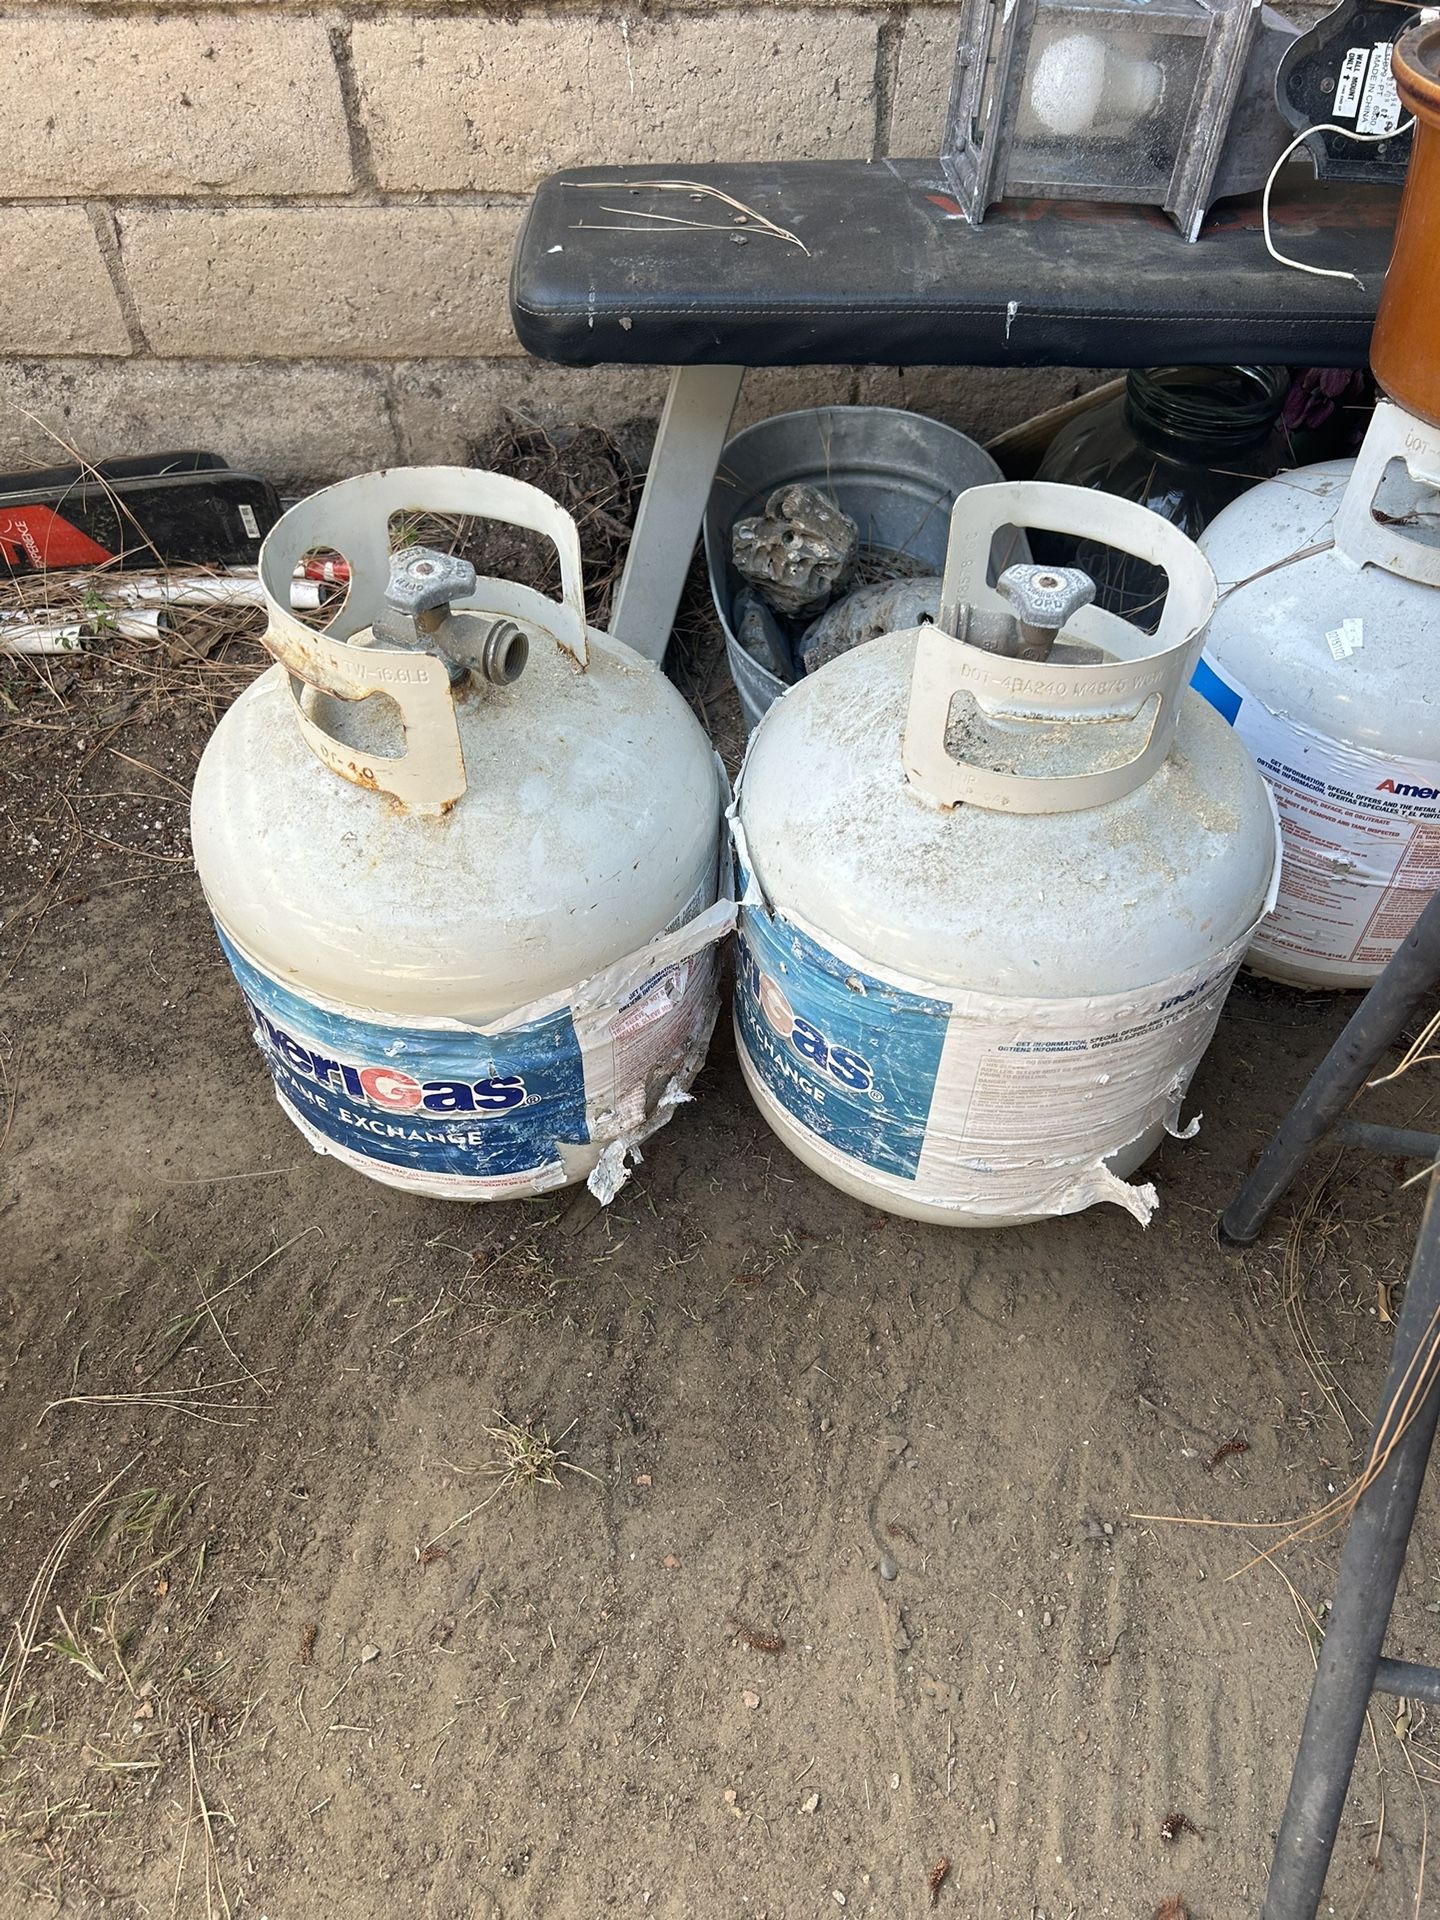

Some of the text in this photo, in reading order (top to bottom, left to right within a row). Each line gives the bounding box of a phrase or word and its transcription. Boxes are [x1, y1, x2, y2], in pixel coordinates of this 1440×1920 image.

[1346, 52, 1355, 71] ONLY
[1347, 53, 1363, 101] WALL MOUNT
[1362, 54, 1381, 123] MADE IN CHINA
[14, 520, 46, 568] EXPERIENCE
[1256, 757, 1281, 775] OBTIENE
[1328, 792, 1357, 805] OFERTAS
[1358, 801, 1399, 814] ESPECIALES
[1270, 758, 1283, 768] GET
[1282, 764, 1326, 789] INFORMATION,
[1327, 784, 1354, 800] SPECIAL
[1356, 794, 1382, 805] OFFERS
[1383, 800, 1398, 808] AND
[1414, 805, 1437, 813] RETAIL
[1367, 827, 1400, 837] INSPECTED
[240, 985, 524, 1112] meriGas
[1090, 1032, 1119, 1044] SPECIAL
[337, 1107, 484, 1146] EXCHANGE
